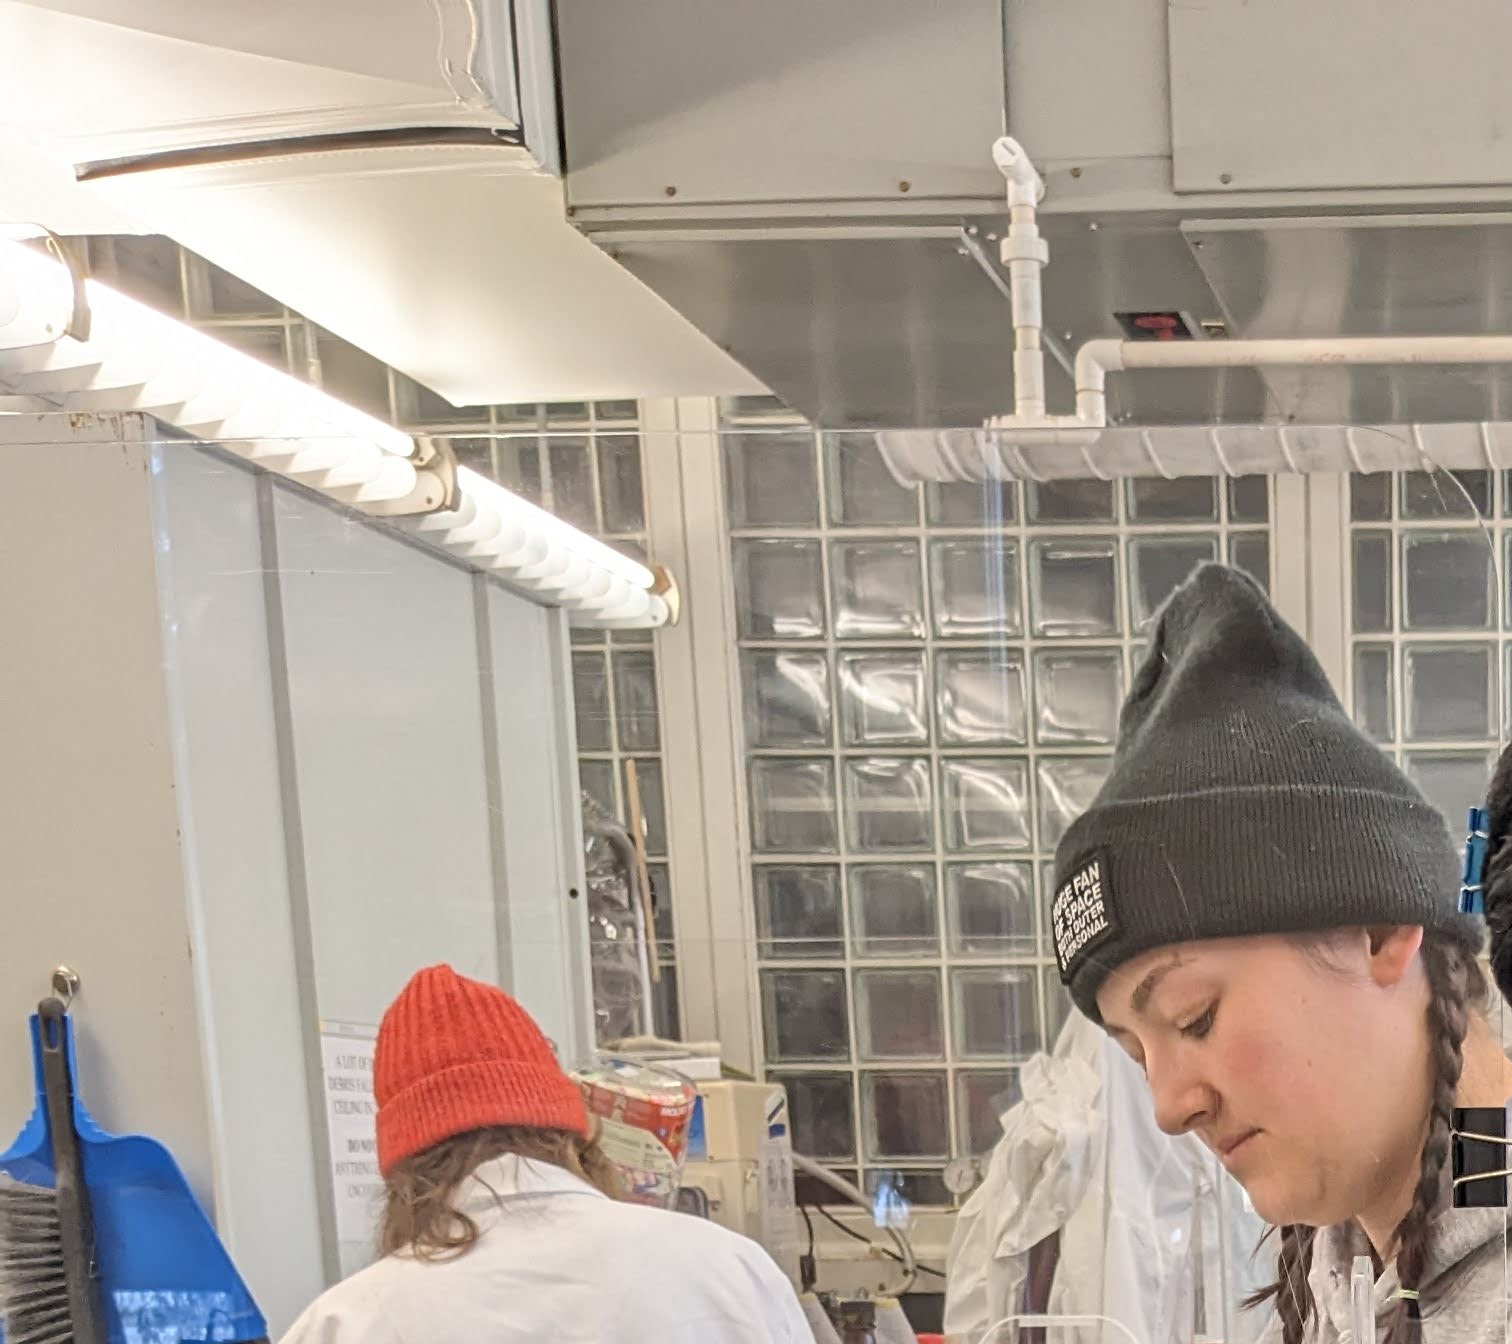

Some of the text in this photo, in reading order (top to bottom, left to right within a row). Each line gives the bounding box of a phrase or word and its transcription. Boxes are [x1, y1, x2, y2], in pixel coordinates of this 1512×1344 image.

[1073, 861, 1101, 896] FAN
[1064, 882, 1103, 926] SPACE
[1072, 900, 1105, 934] OUTER
[1064, 915, 1109, 963] PERSONAL
